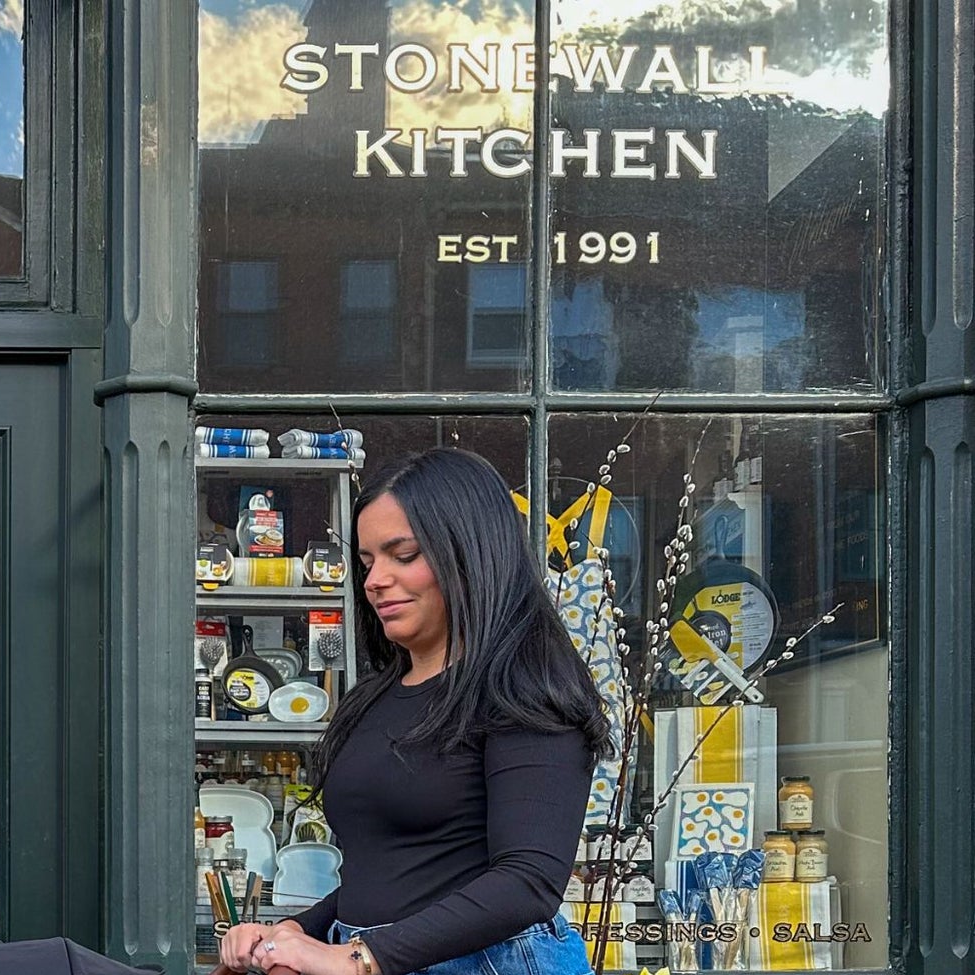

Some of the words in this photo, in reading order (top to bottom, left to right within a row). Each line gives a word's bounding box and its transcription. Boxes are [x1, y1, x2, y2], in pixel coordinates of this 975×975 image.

[280, 42, 793, 94] STONEWALL
[352, 128, 718, 179] KITCHEN
[437, 233, 518, 264] EST
[553, 231, 661, 264] 1991
[711, 591, 741, 604] LODGE
[773, 922, 873, 943] SALSA
